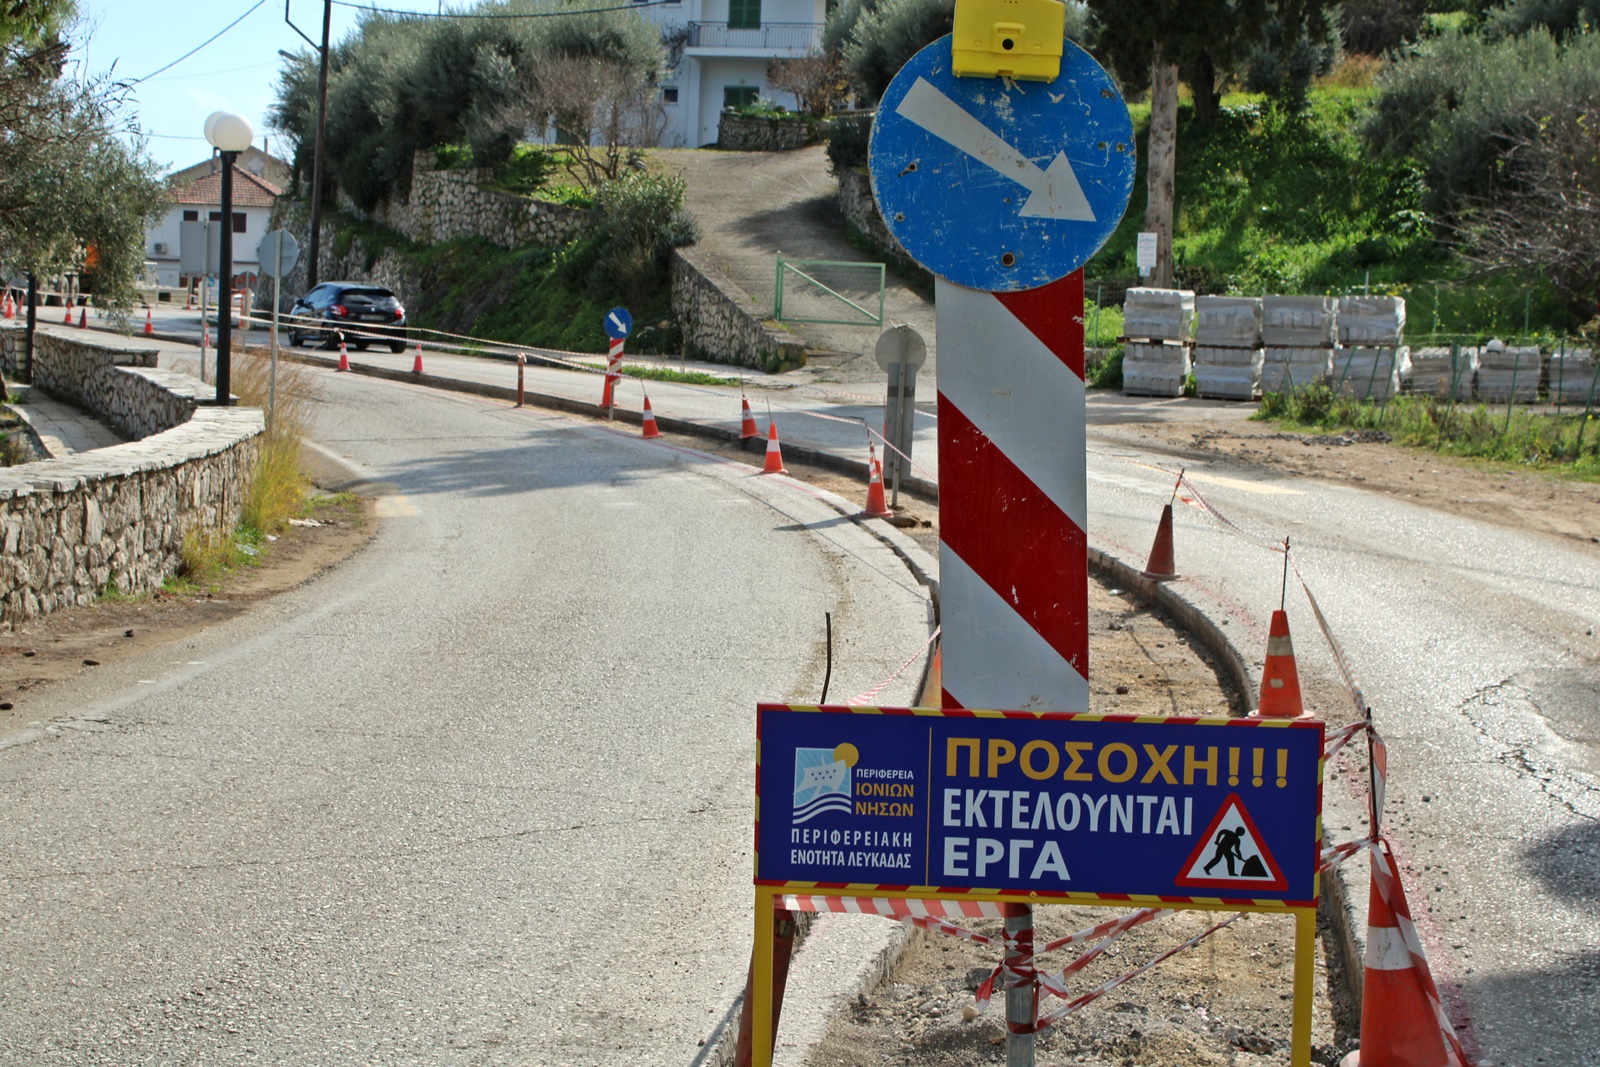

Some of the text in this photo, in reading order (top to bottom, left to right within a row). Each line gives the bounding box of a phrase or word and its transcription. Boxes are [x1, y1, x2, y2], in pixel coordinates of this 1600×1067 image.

[946, 737, 1288, 788] ΠΡΟΣΟΧΗ!!!
[856, 768, 914, 780] ΠΕΡΙΦΕΡΕΙΑ
[856, 782, 914, 798] ΙΟΝΙΩΝ
[855, 801, 914, 817] ΝΗΣΩΝ
[943, 788, 1193, 836] ΕΚΤΕΛΟΥΝΤΑΙ
[791, 828, 912, 848] ΠΕΡΙΦΕΡΕΙΑΚΗ
[791, 849, 912, 869] ΕΝΟΤΗΤΑ ΛΕΥΚΑΔΑΣ
[943, 836, 1071, 881] ΕΡΓΑ
